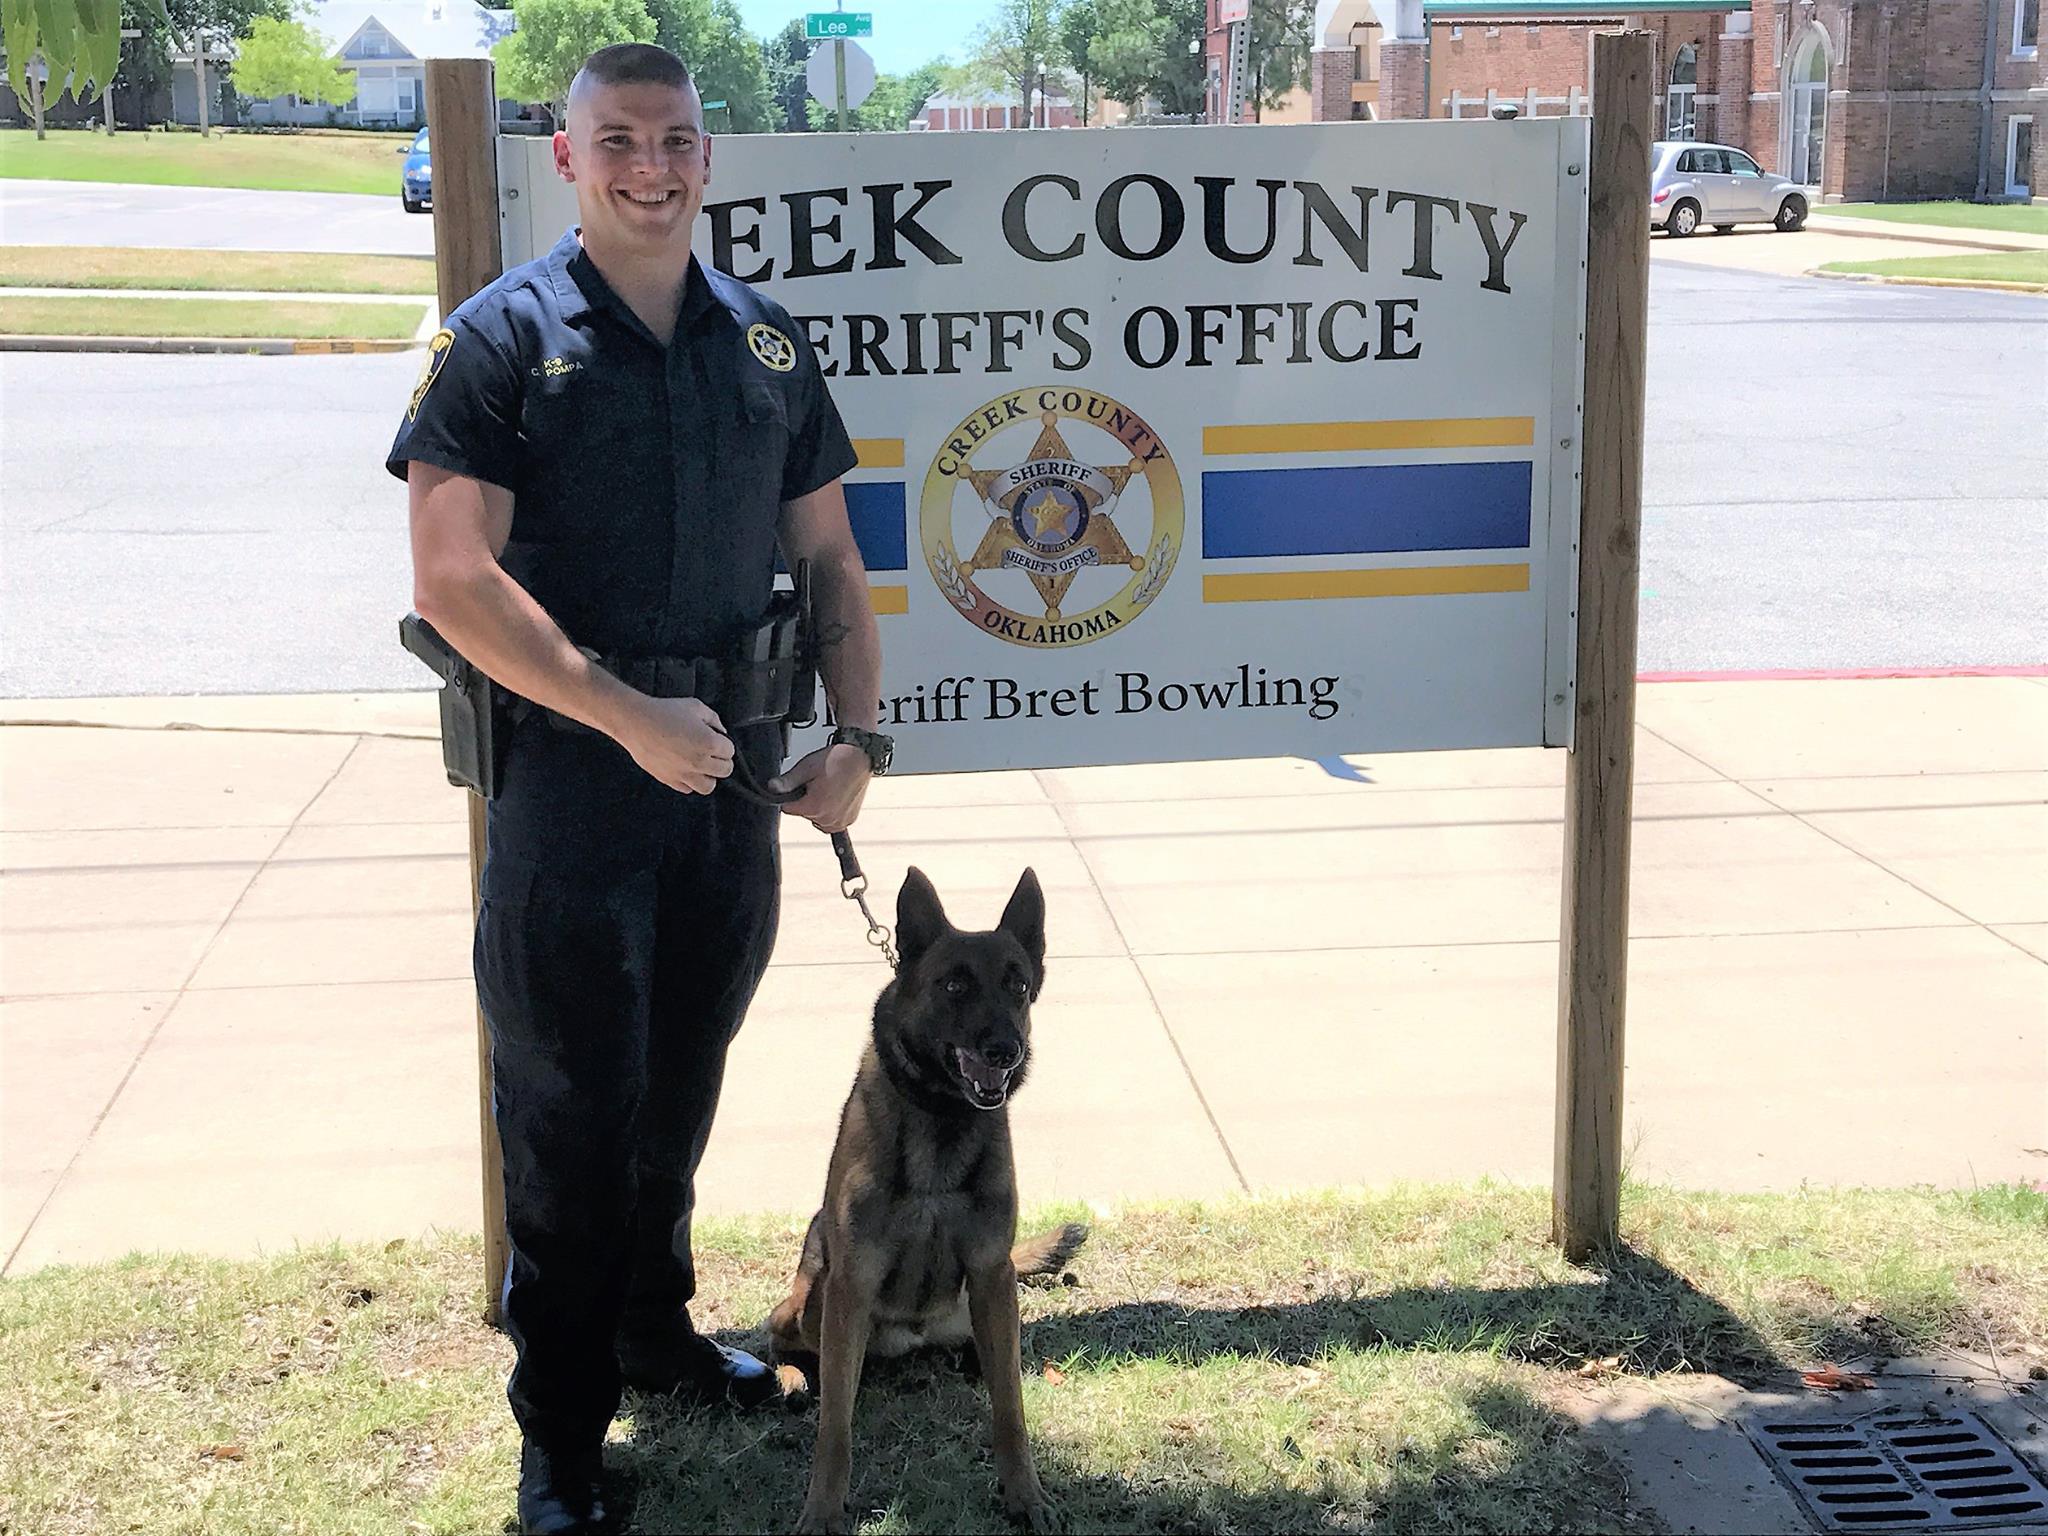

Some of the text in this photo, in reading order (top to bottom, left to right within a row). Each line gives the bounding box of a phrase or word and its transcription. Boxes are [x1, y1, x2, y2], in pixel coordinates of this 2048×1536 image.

[818, 19, 848, 34] Lee
[702, 173, 1528, 294] EEK COUNTY
[793, 298, 1423, 377] ERIFF'S OFFICE
[545, 361, 584, 378] POMPA
[937, 390, 1166, 477] CREEK COUNTY
[1009, 462, 1092, 485] SHERIFF
[1006, 547, 1098, 573] SHERIFF'S OFFICE
[983, 609, 1122, 643] OKLAHOMA
[792, 664, 1340, 729] riff Bret Bowling
